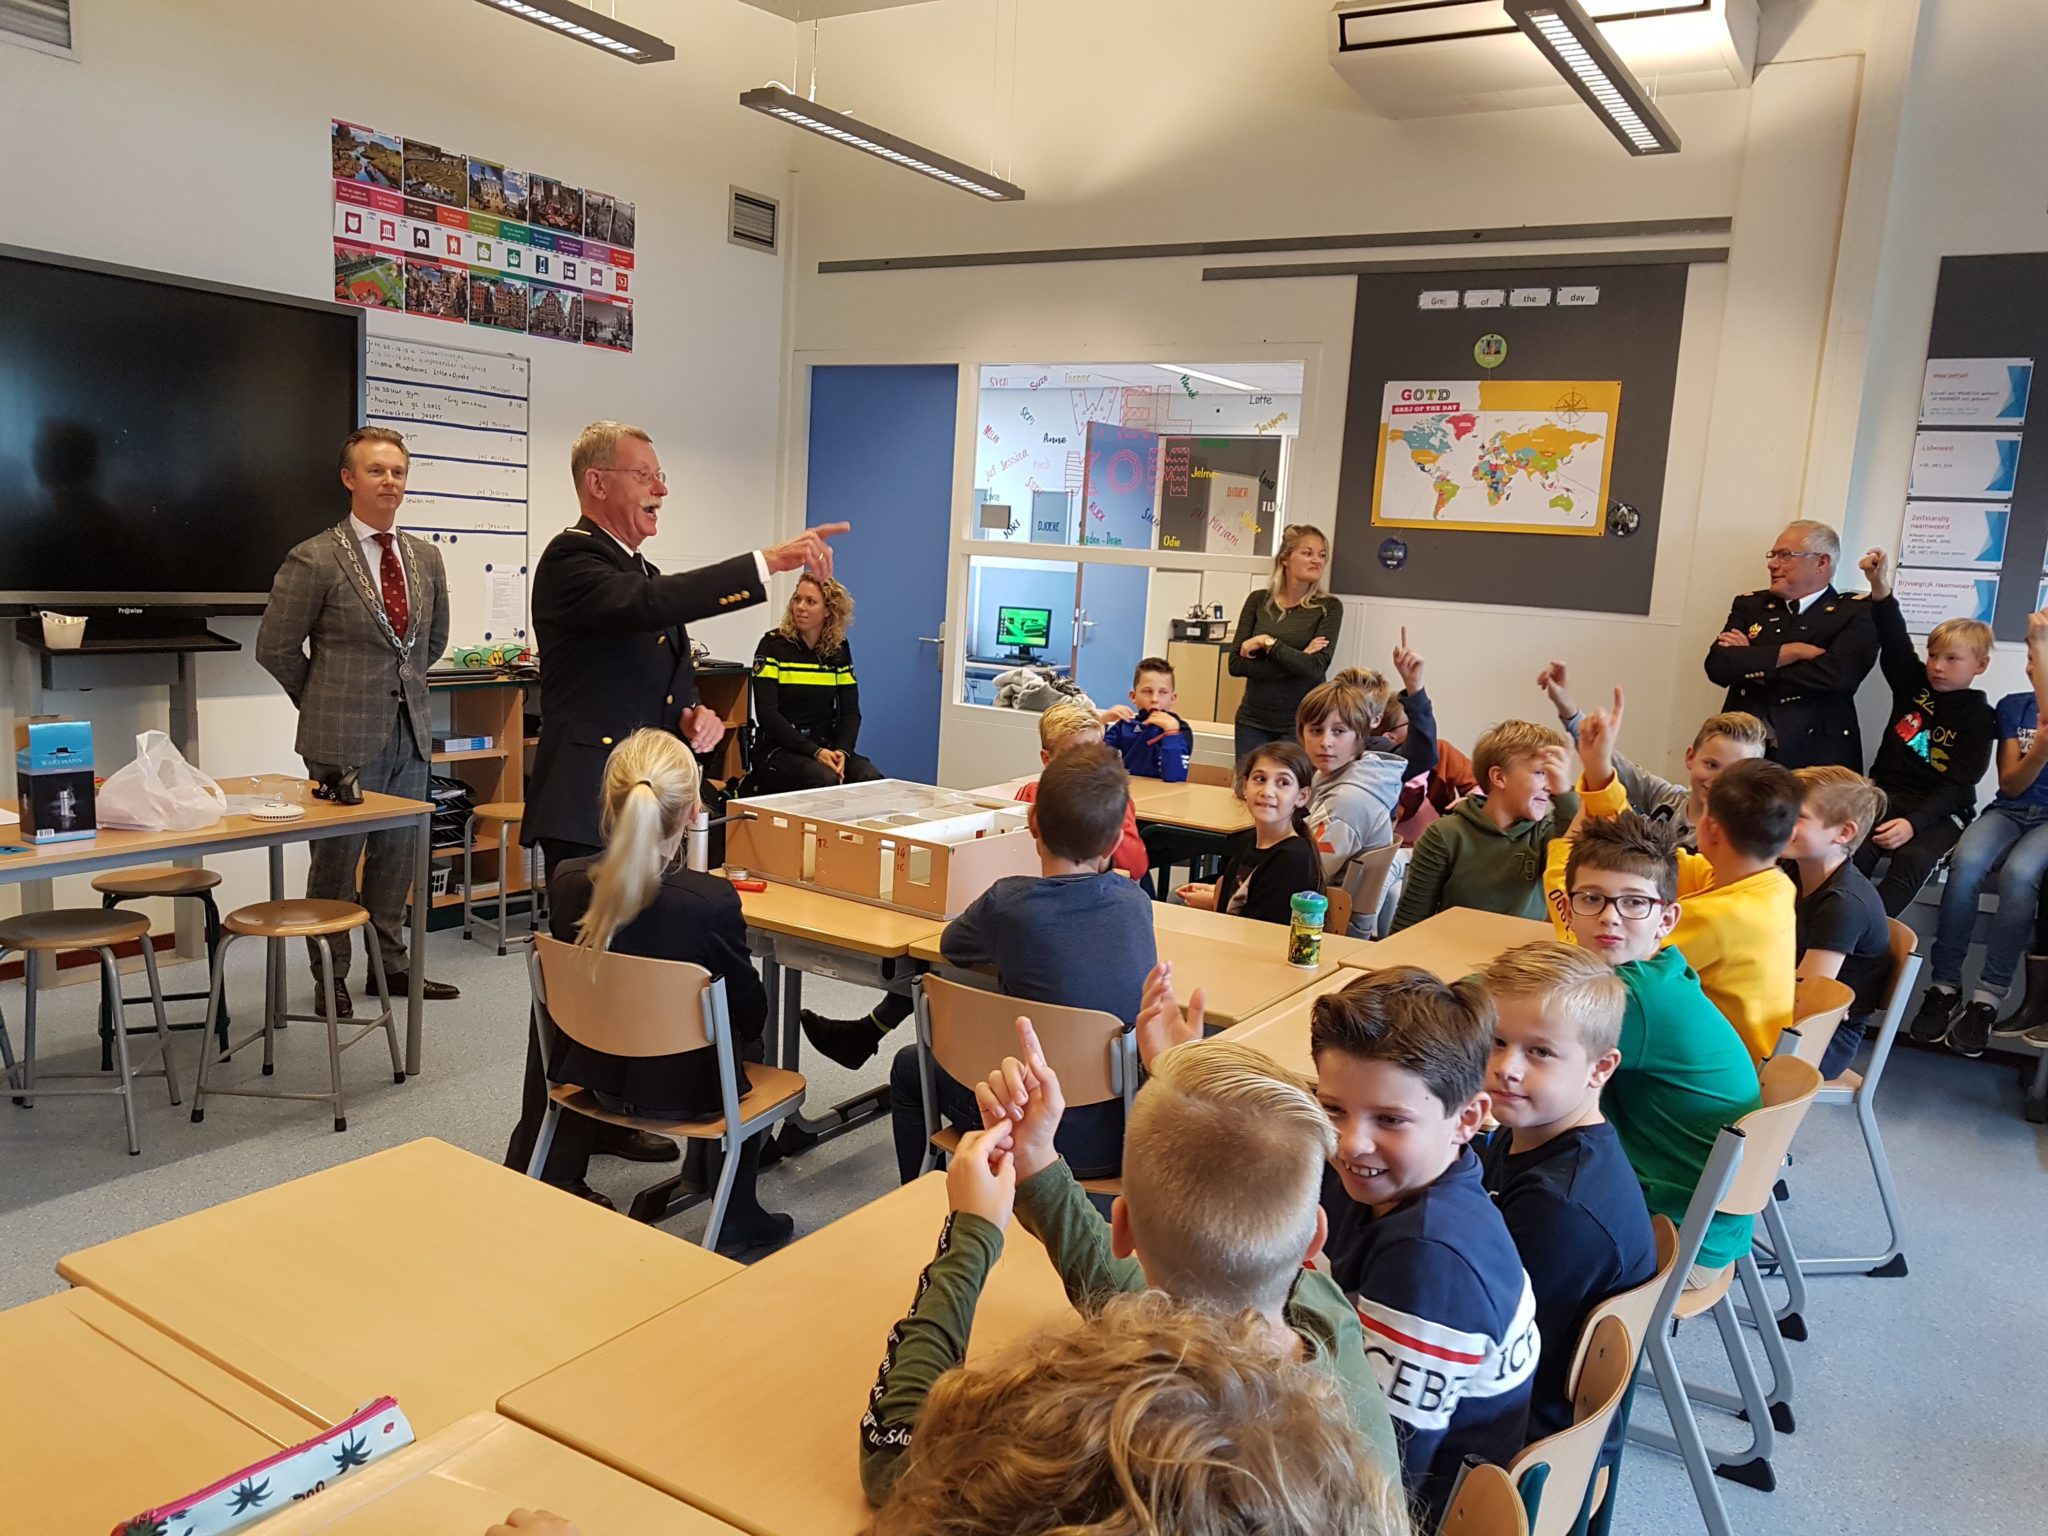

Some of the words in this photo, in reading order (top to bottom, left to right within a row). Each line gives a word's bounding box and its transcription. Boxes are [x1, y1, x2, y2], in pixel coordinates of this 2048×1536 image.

[1431, 297, 1447, 306] Grej
[1481, 298, 1490, 306] of
[1523, 295, 1537, 303] the
[1570, 293, 1586, 303] day
[405, 390, 419, 399] gym
[1249, 394, 1273, 405] Lotte
[1401, 388, 1451, 401] GOTD
[404, 432, 418, 441] gym
[1042, 432, 1067, 444] Anne
[1000, 448, 1030, 472] Jessica
[1163, 534, 1182, 548] Odie
